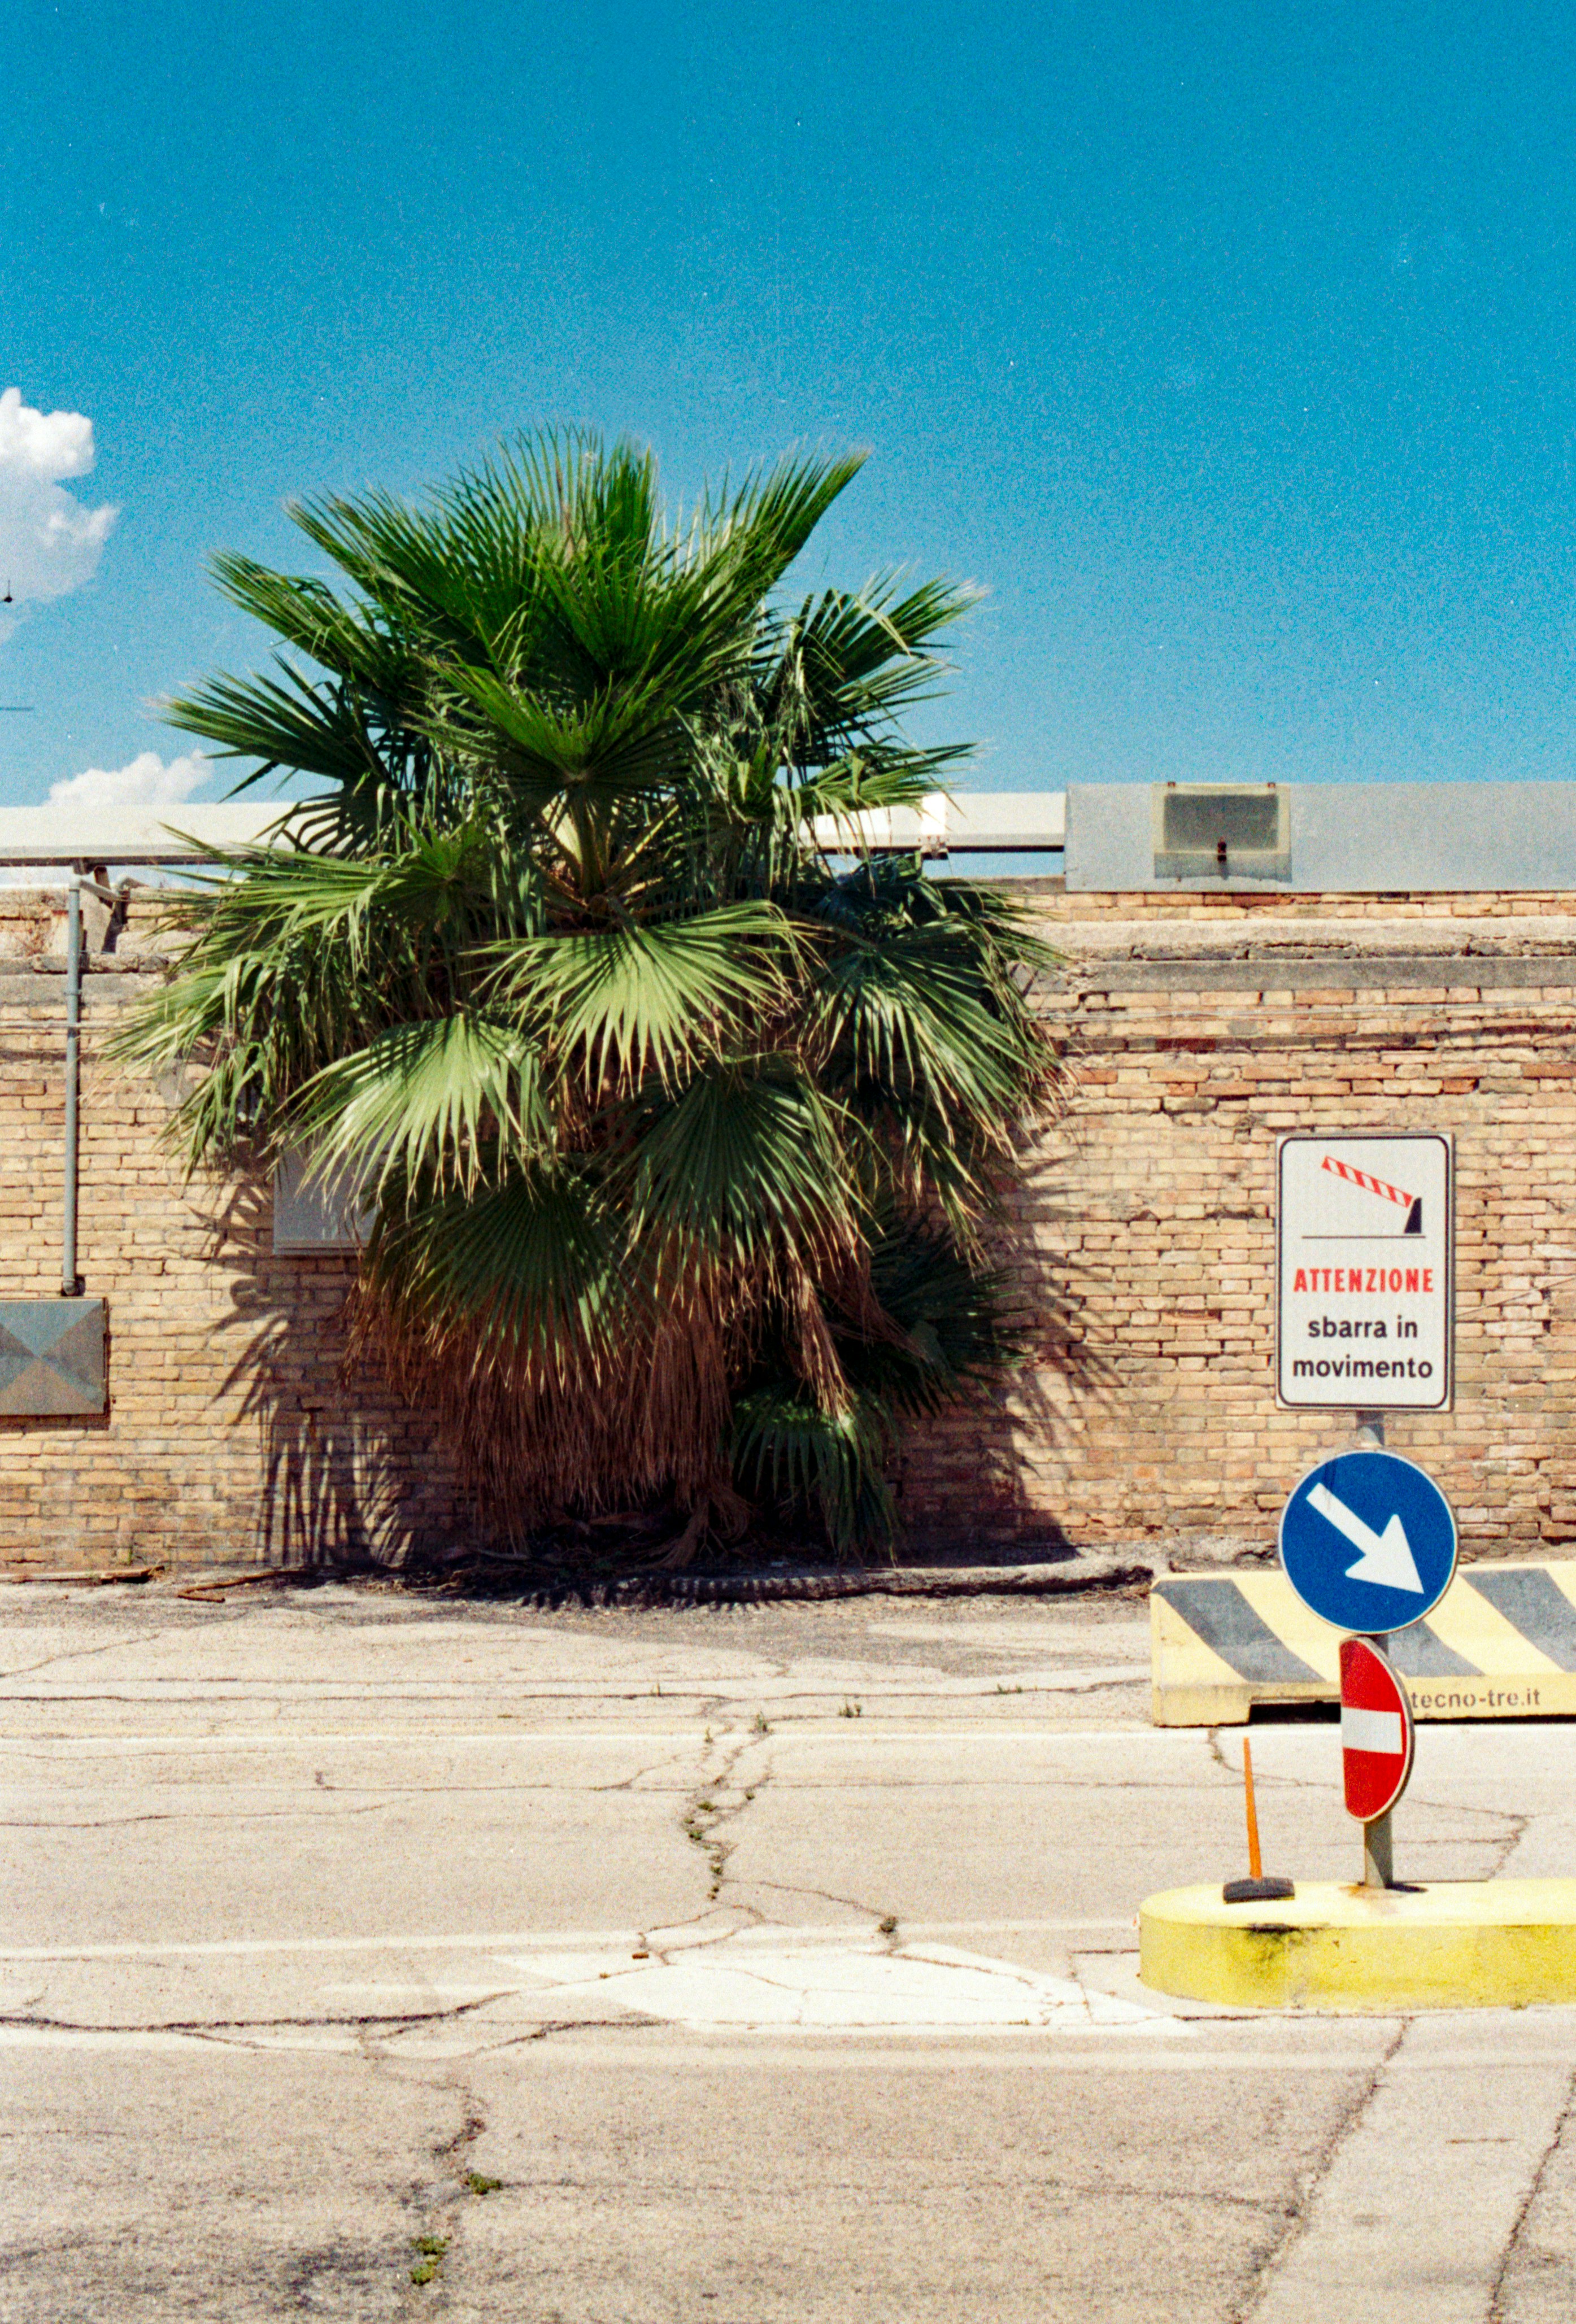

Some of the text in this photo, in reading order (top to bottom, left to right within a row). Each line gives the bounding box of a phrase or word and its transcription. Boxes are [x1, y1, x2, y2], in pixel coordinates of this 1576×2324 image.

[1293, 1268, 1434, 1293] ATTENZIONE
[1308, 1315, 1418, 1338] sbarra in
[1292, 1354, 1433, 1378] movimento
[1412, 1688, 1540, 1708] tecno-tre.it
